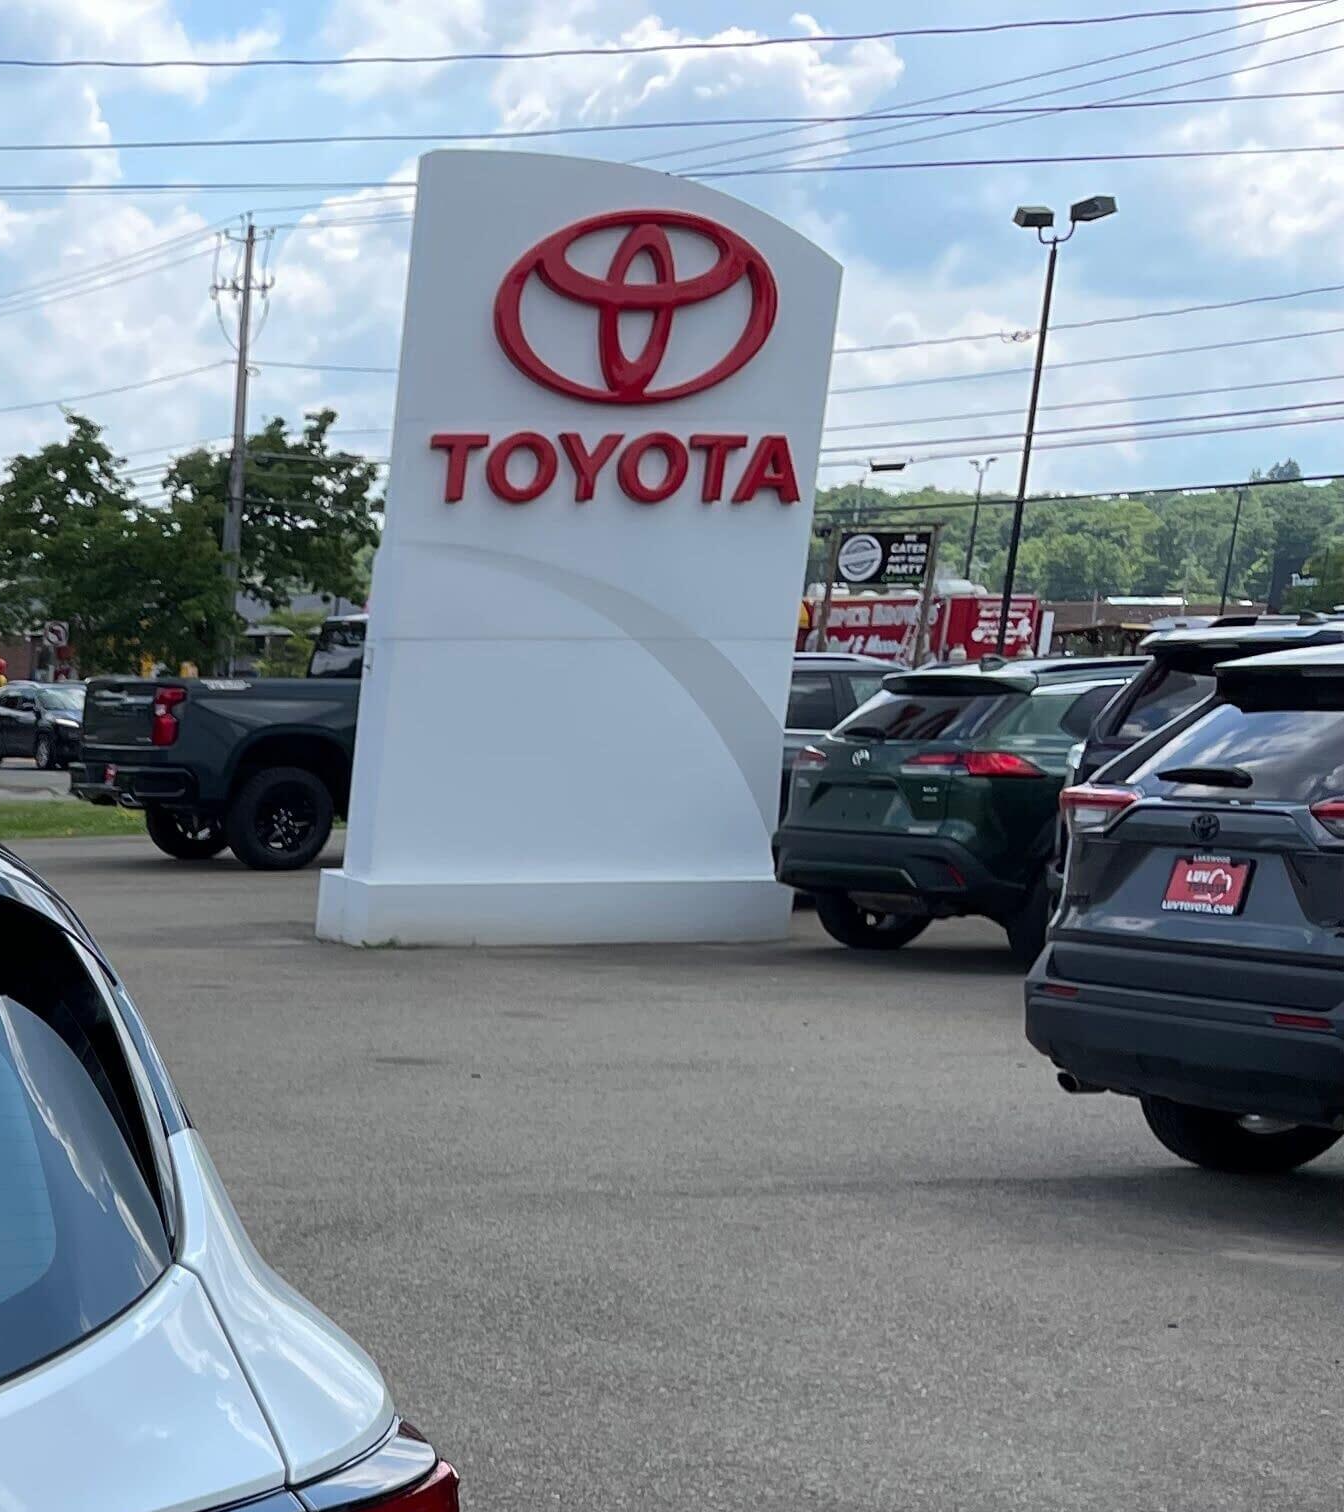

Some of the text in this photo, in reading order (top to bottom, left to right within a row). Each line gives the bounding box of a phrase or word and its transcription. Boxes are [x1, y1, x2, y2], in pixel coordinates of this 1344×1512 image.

[430, 431, 801, 505] TOYOTA
[890, 542, 928, 554] CATER
[885, 563, 923, 575] PARTY
[1186, 869, 1211, 882] LUV
[1162, 900, 1234, 915] LUVTOYOTA.COM
